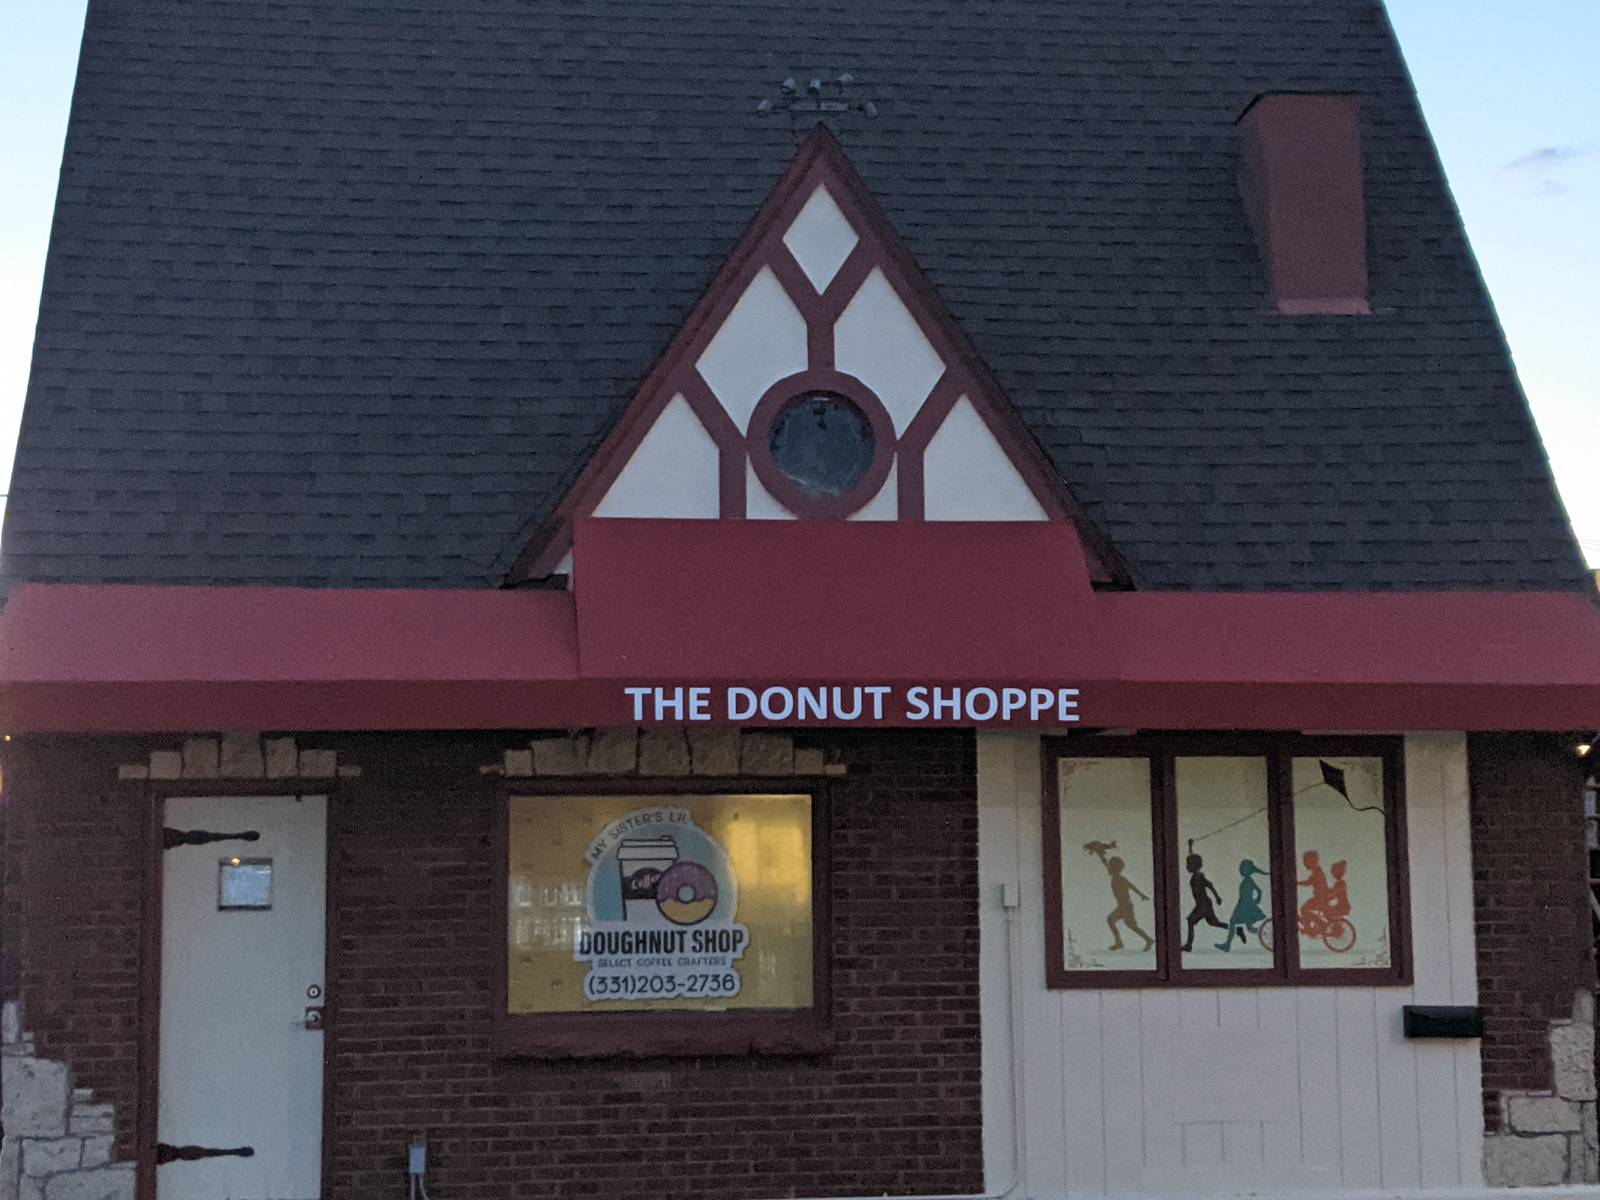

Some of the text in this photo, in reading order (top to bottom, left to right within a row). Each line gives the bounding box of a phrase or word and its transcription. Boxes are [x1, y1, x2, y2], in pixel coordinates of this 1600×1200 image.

[624, 686, 1080, 721] THE DONUT SHOPPE
[591, 839, 608, 859] MY
[609, 811, 664, 839] SISTER'S
[580, 929, 744, 955] DOUGHNUT SHOP
[598, 956, 727, 968] SELECT COFFEE CRAFTERS
[589, 974, 736, 995] (331)203-2736
